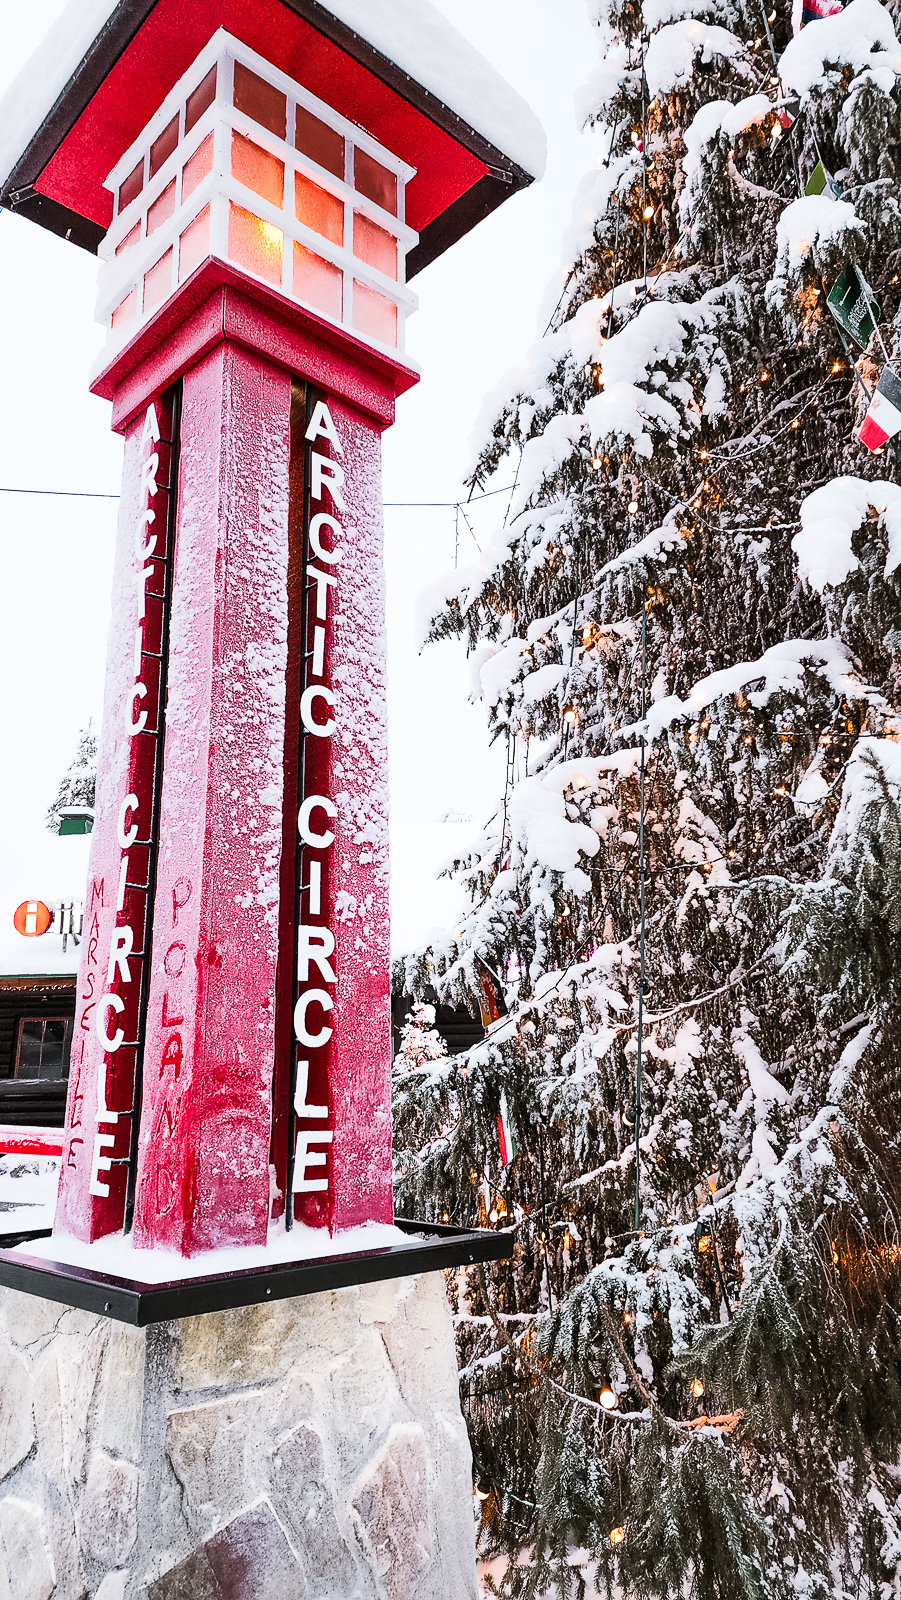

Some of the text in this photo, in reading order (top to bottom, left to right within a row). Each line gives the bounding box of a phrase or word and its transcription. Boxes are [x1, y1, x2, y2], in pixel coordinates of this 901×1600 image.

[67, 876, 105, 1171] MARSEILLE
[89, 402, 161, 1198] ARCTIC CIRCLE
[155, 876, 193, 1215] POLAND
[291, 400, 347, 1193] ARCTIC CIRCLE
